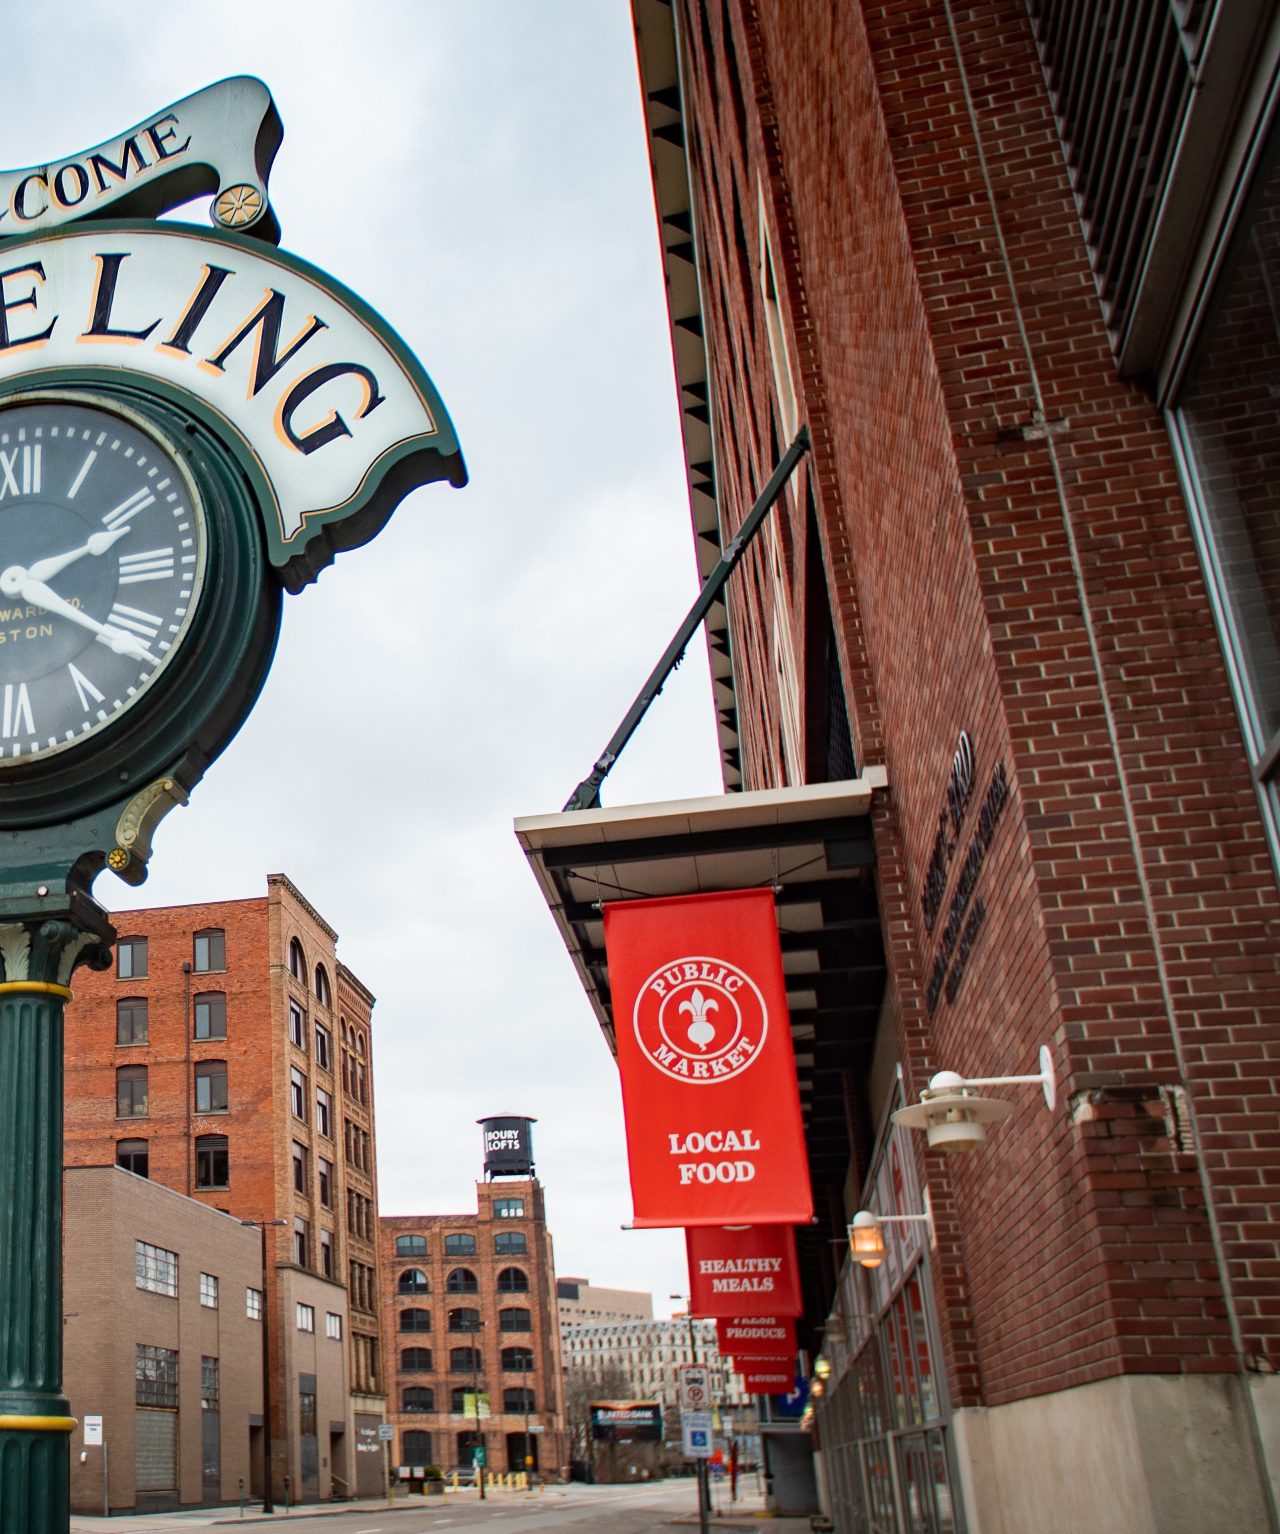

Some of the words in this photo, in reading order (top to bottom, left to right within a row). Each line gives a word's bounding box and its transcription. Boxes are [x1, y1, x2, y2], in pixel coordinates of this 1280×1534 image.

[0, 443, 42, 501] XII
[101, 486, 157, 532] II
[118, 546, 175, 585] III
[66, 662, 106, 712] V
[2, 682, 37, 739] VI
[650, 962, 744, 998] PUBLIC
[652, 1035, 756, 1079] MARKET
[488, 1130, 519, 1141] BOURY
[488, 1140, 520, 1151] LOFTS
[668, 1129, 761, 1155] LOCAL
[678, 1160, 756, 1185] FOOD
[699, 1257, 783, 1274] HEALTHY
[711, 1276, 774, 1293] MEALS
[725, 1327, 787, 1339] PRODUCE
